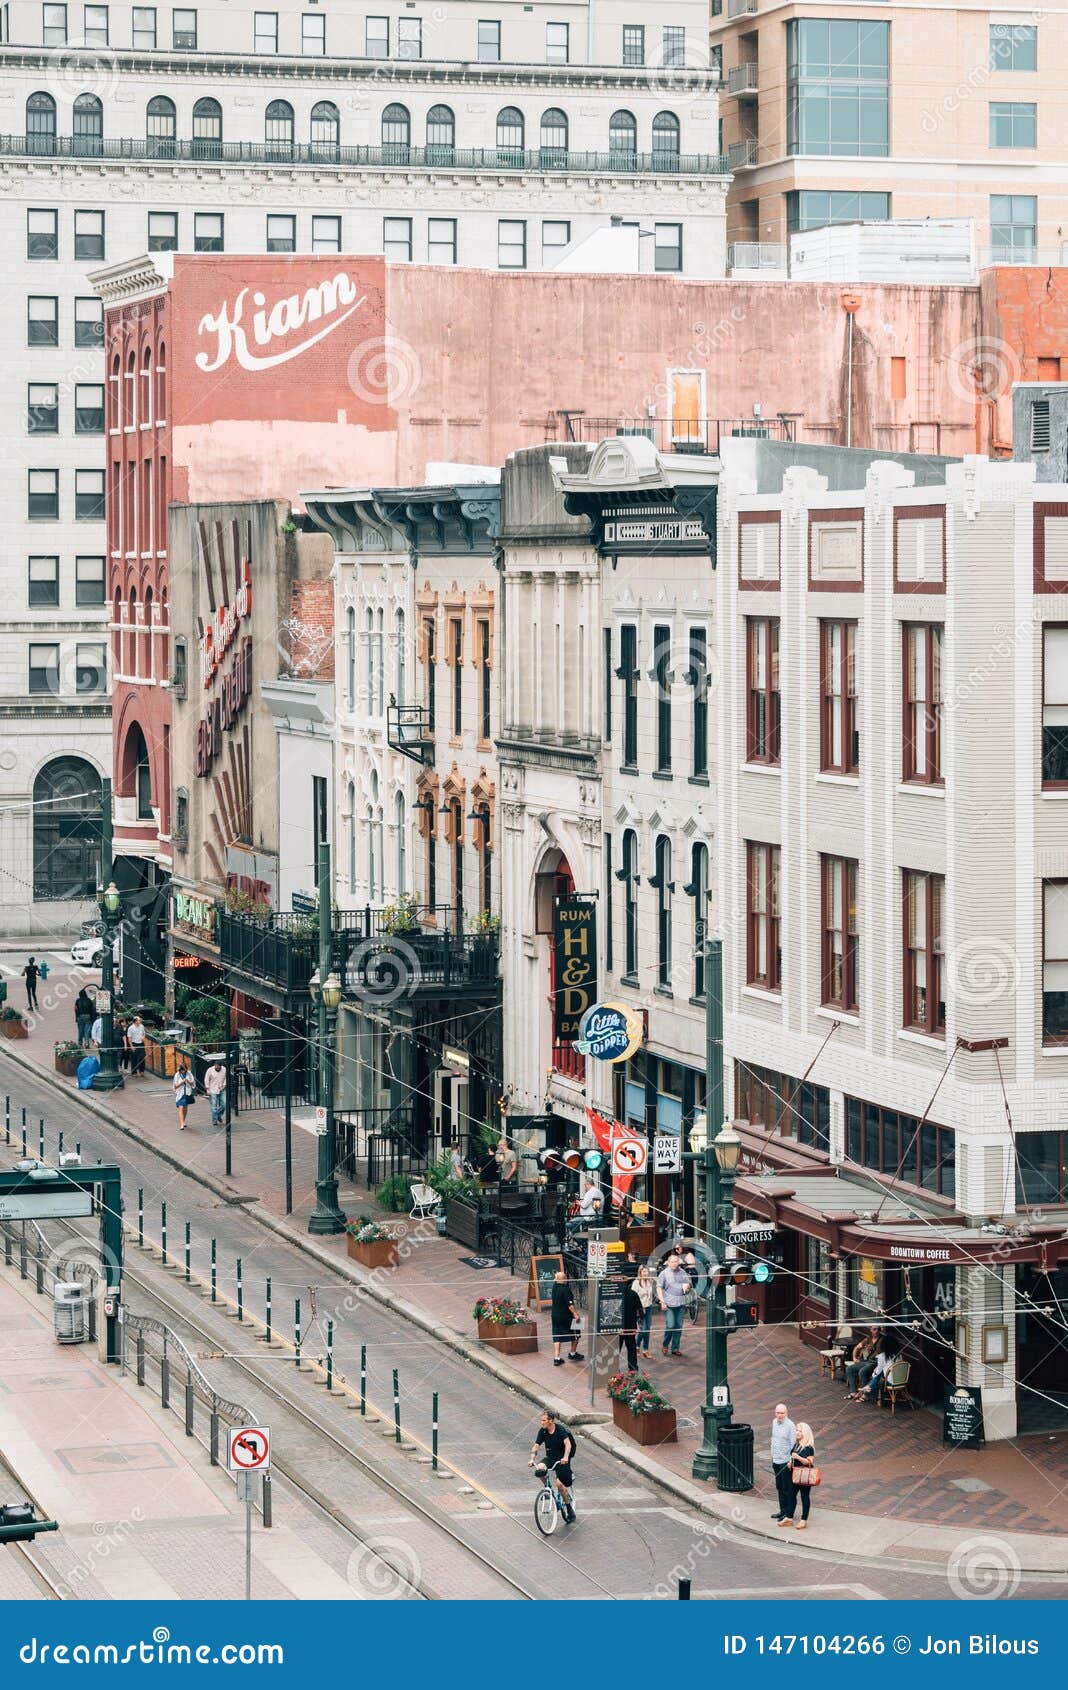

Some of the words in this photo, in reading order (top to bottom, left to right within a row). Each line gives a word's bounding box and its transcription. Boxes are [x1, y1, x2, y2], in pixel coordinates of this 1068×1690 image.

[195, 272, 366, 372] Kiam
[649, 523, 680, 539] STUART
[559, 910, 591, 921] RUM
[561, 1022, 580, 1033] BA
[587, 1013, 620, 1038] Little
[657, 1138, 678, 1149] ONE
[657, 1149, 678, 1159] WAY
[728, 1230, 773, 1245] CONGRESS
[890, 1246, 925, 1258] BOOMTOWN
[926, 1249, 950, 1260] COFFEE
